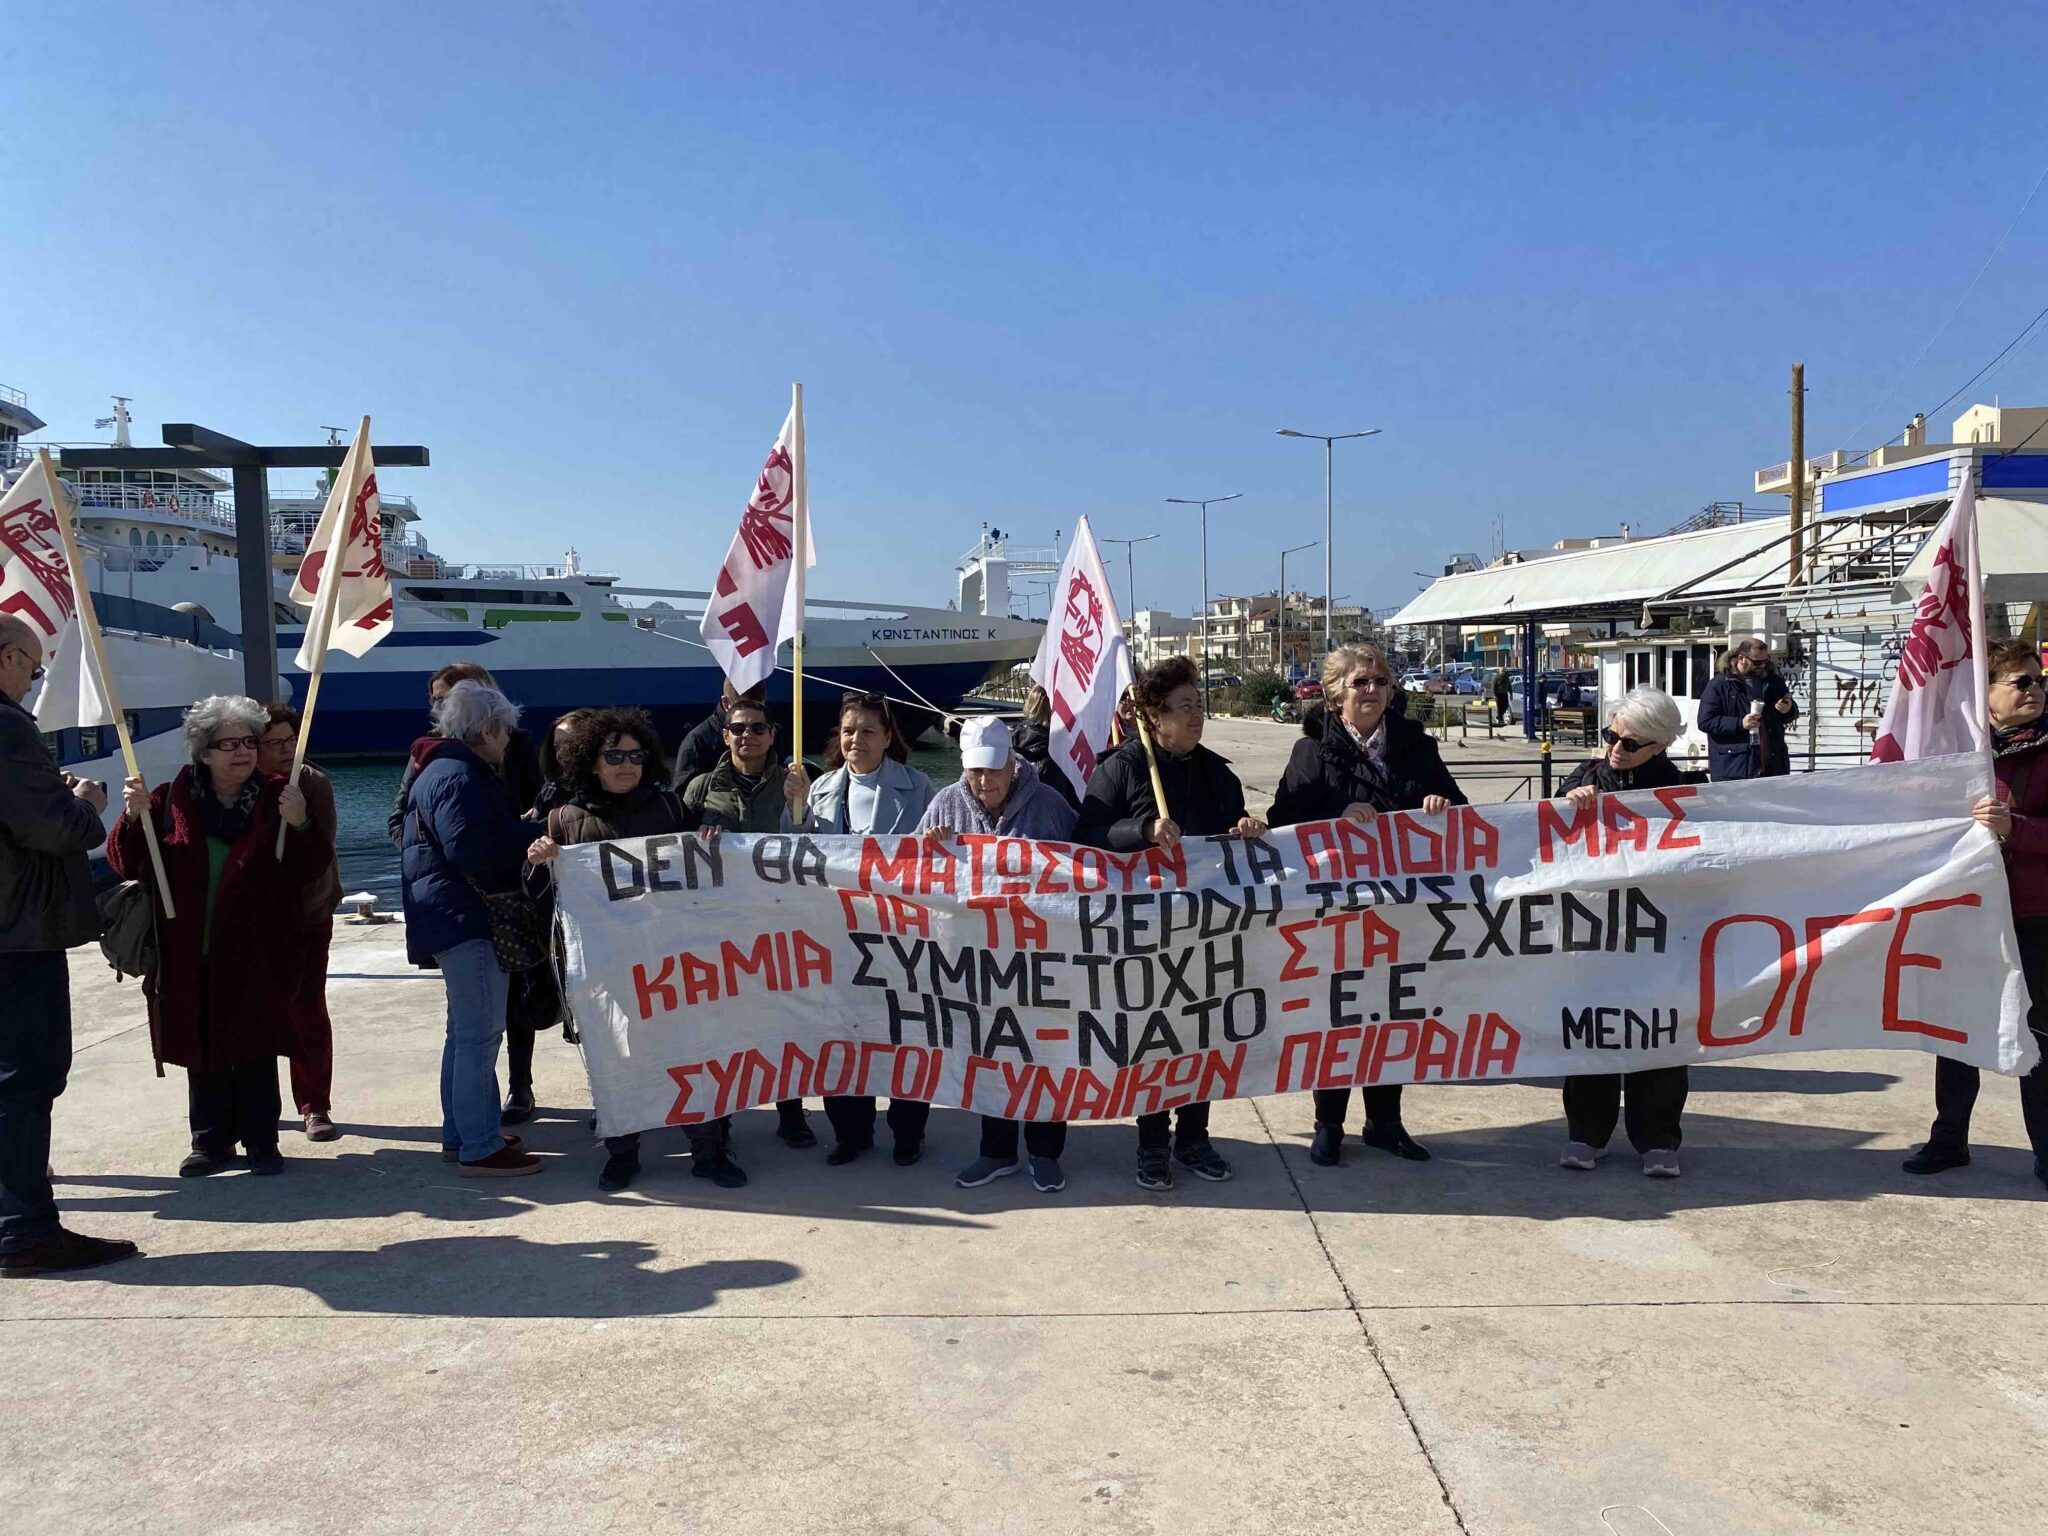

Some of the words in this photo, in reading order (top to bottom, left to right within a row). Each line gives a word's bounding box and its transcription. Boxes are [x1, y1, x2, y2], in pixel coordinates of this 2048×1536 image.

[872, 628, 980, 641] ΚΩΝΣΤΑΝΤΙΝΟΣ
[988, 628, 997, 640] Κ
[599, 834, 725, 901] ΔΕΝ
[751, 834, 830, 888] ΘΑ
[858, 833, 1188, 896] ΜΑΤΩΣΟΥΝ
[1204, 834, 1287, 887] ΤΑ
[1294, 804, 1500, 881] ΠΑΙΔΙΑ
[1537, 785, 1702, 864] ΜΑΣ
[632, 929, 832, 1020] ΚΑΜΙΑ
[848, 932, 1245, 1012] ΣΥΜΜΕΤΟΧΗ
[1278, 909, 1401, 983] ΣΤΑ
[1426, 886, 1668, 961] ΣΧΕΔΙΑ
[836, 889, 930, 939] ΓΙΑ
[966, 894, 1049, 950] ΤΑ
[1077, 884, 1284, 955] ΚΕΡΔΗ
[1562, 1006, 1679, 1051] ΜΕΛΗ
[1696, 893, 1982, 1047] ΟΓΕ
[665, 1040, 943, 1126] ΣΥΛΛΟΓΟΙ
[960, 1042, 1248, 1122] ΓΥΝΑΙΚΩΝ
[1274, 1012, 1522, 1094] ΠΕΙΡΑΙΑ
